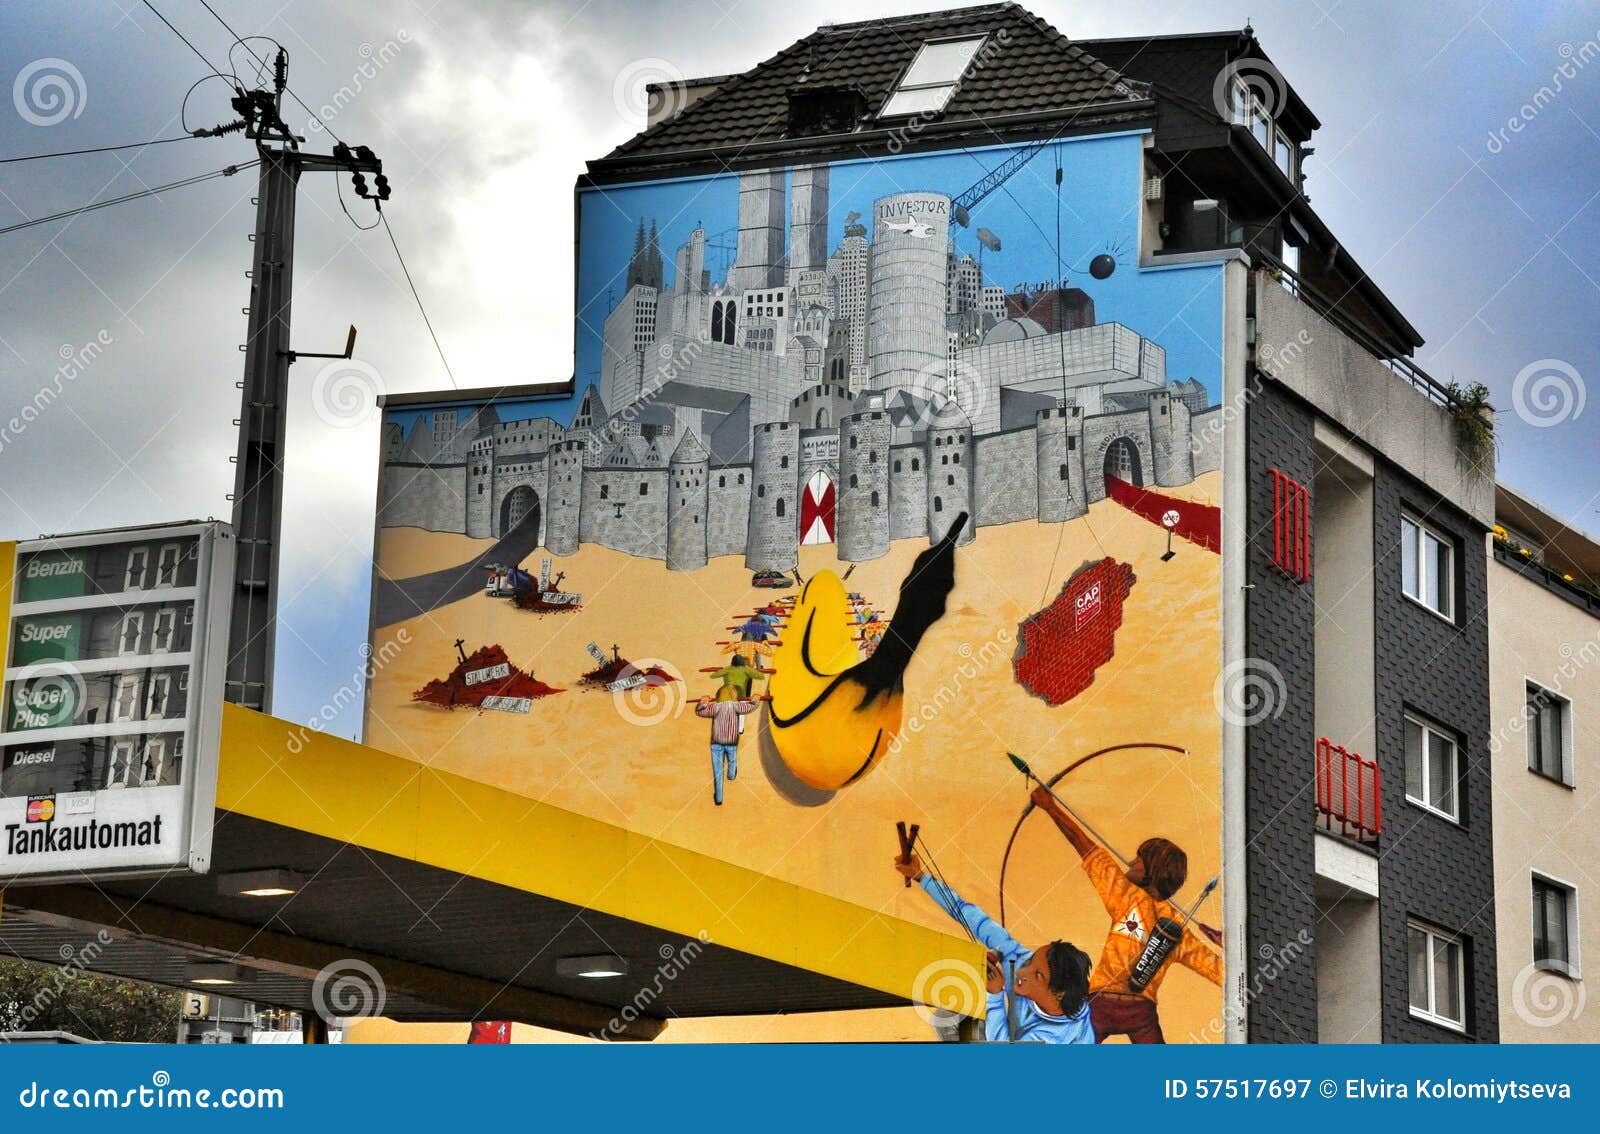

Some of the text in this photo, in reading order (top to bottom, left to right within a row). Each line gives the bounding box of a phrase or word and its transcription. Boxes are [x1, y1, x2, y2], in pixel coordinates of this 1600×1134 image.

[880, 200, 946, 219] INVESTOR
[26, 558, 83, 578] Benzin
[1077, 586, 1099, 608] CAP
[21, 624, 72, 644] Super
[15, 687, 68, 708] Super
[12, 709, 50, 729] Plus
[13, 748, 56, 765] Diesel
[5, 815, 162, 855] Tankautomat
[1136, 936, 1160, 971] CAPTAIN
[190, 1000, 202, 1016] 3
